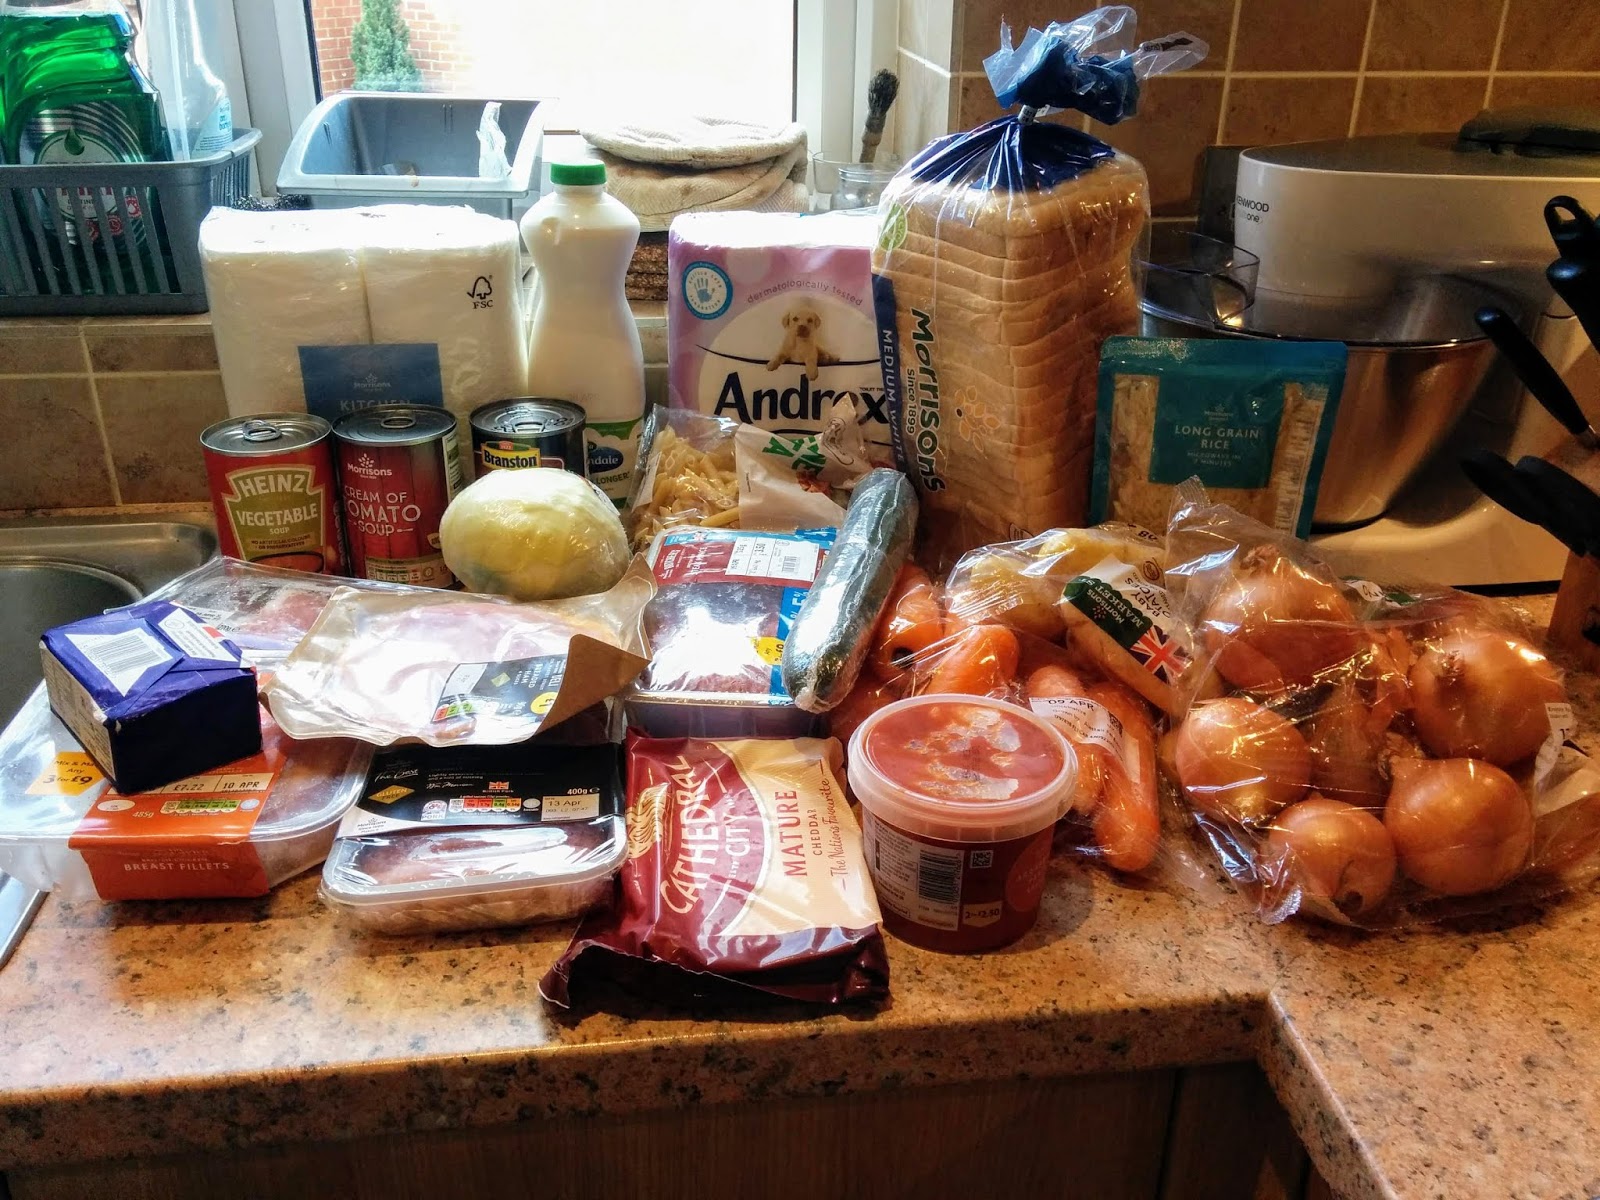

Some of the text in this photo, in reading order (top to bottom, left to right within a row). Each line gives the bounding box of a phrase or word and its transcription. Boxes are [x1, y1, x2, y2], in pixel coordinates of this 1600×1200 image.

[1237, 196, 1270, 212] ENWOOD
[747, 280, 863, 306] dermatologically tested
[472, 300, 493, 309] FSC
[882, 329, 904, 463] MEDIUM WHITE
[906, 368, 917, 435] Since 1899
[911, 307, 946, 492] Morrisons
[1175, 425, 1259, 439] LONG GRAIN
[1201, 439, 1230, 449] RICE
[484, 450, 537, 468] Branston
[347, 463, 393, 476] Morrisons
[238, 474, 306, 498] HEINZ
[344, 485, 407, 503] CREAM OF
[236, 503, 318, 527] VEGETABLE
[269, 526, 290, 535] SOUP
[358, 520, 395, 536] SOUP
[1087, 589, 1125, 624] Morrisons
[1125, 577, 1171, 618] OTATOES
[1130, 592, 1160, 617] BABY
[1095, 586, 1144, 628] MARKET
[1070, 700, 1094, 711] APR
[43, 775, 56, 783] 3
[71, 775, 93, 784] £9
[239, 781, 260, 789] APR
[376, 787, 408, 798] GLUTEN
[819, 778, 838, 825] Favourite
[563, 800, 581, 808] Apr
[659, 754, 721, 914] CATHEDRAL
[723, 812, 751, 857] CITY
[775, 790, 808, 877] MATURE
[807, 808, 823, 856] CHEDDAR
[124, 862, 230, 871] BREAST FILLETS
[830, 859, 849, 877] The
